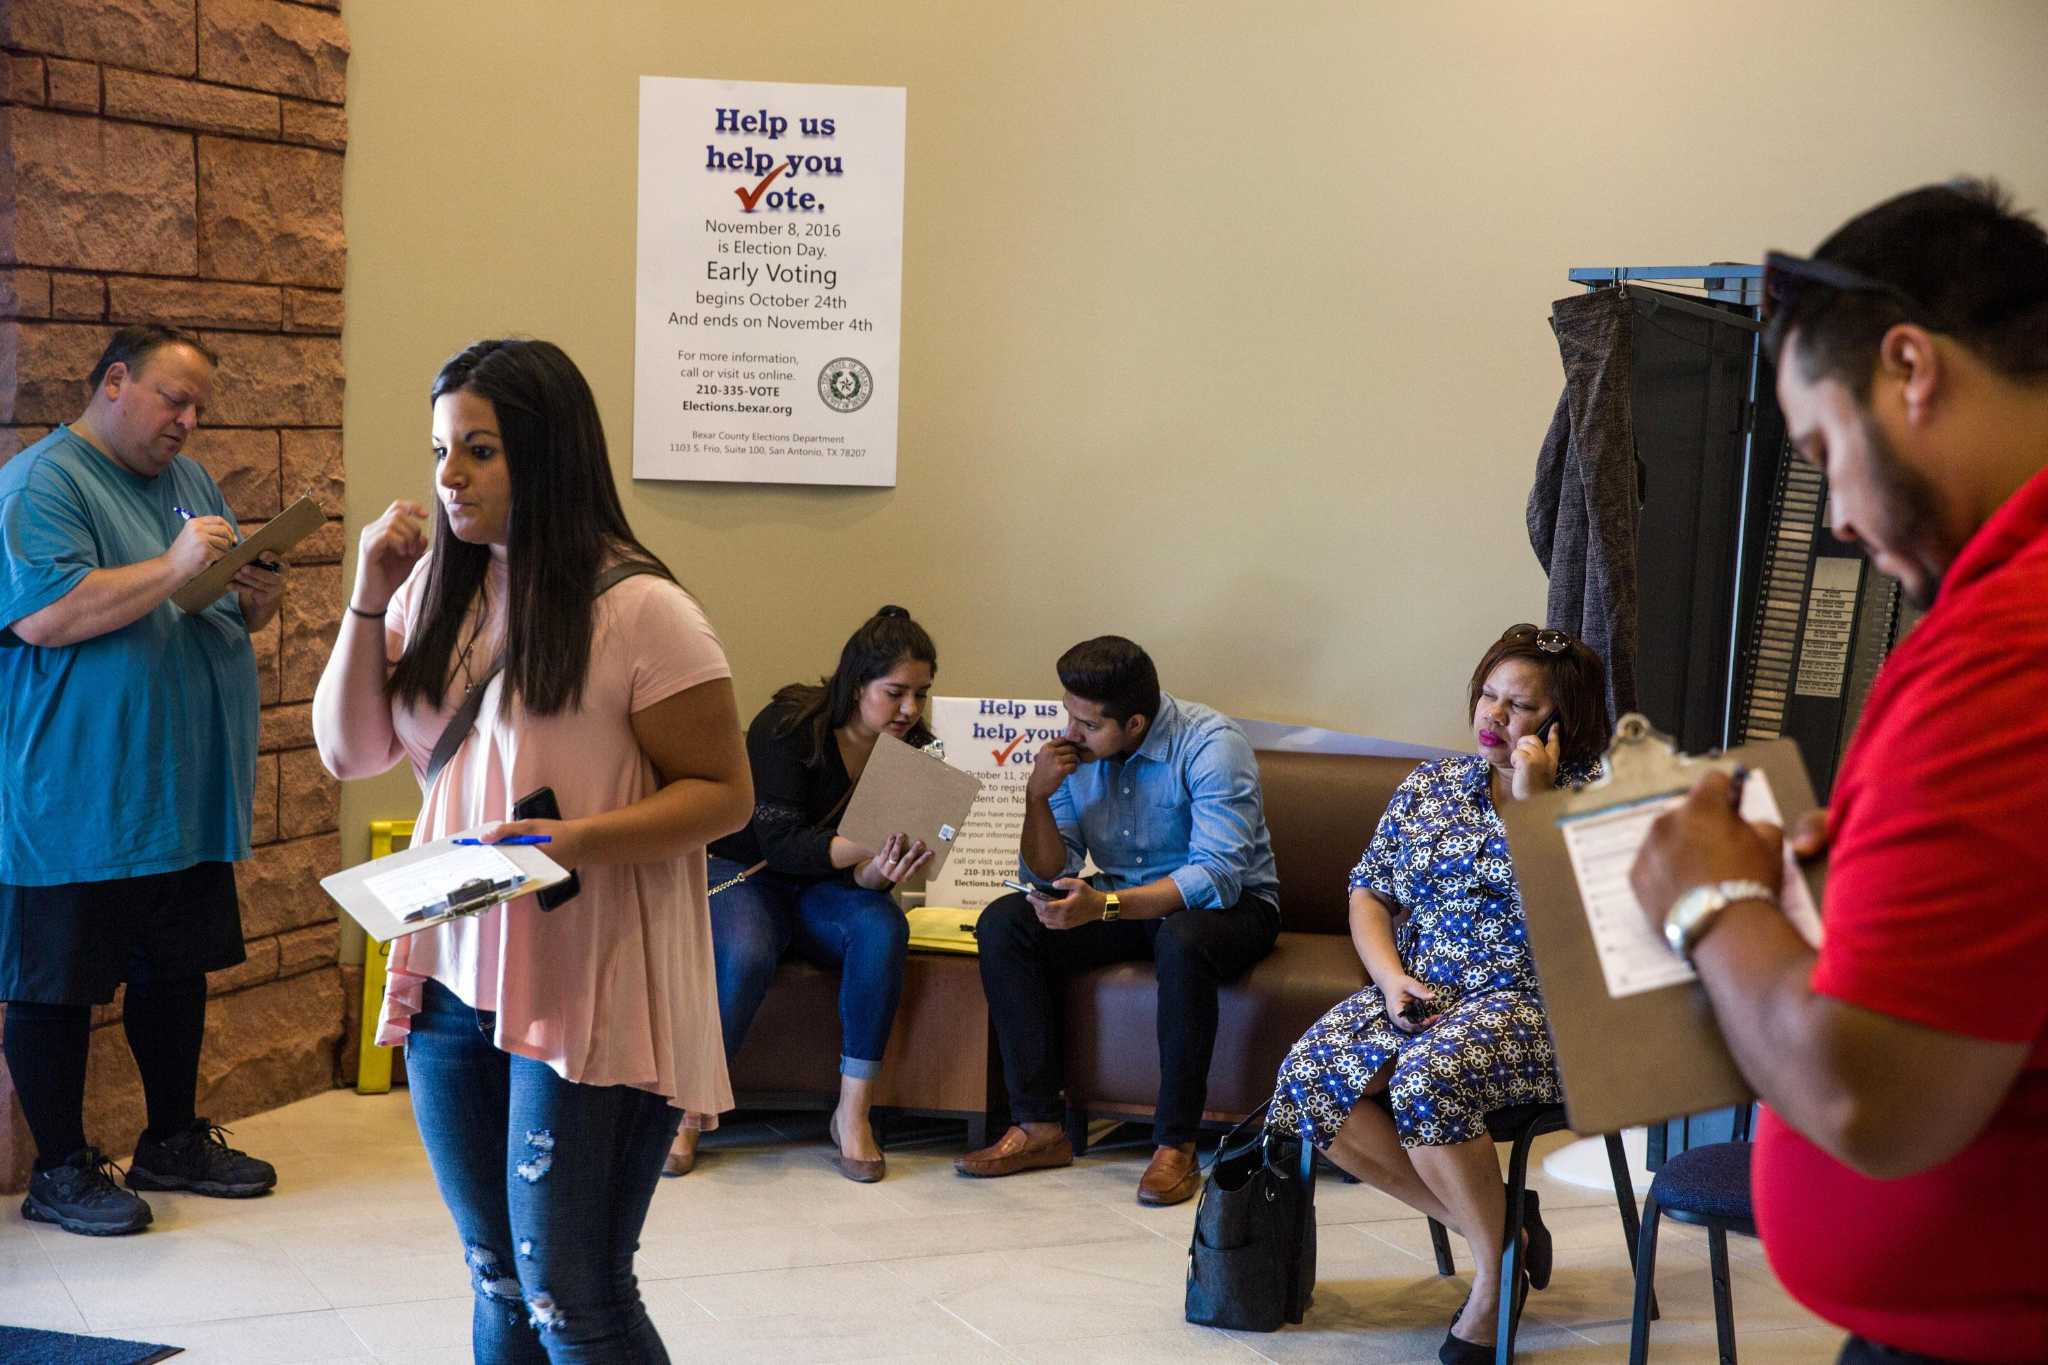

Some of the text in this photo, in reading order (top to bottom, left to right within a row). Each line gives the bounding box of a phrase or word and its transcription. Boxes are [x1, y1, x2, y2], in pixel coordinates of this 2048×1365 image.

[716, 108, 836, 139] Help us
[706, 145, 843, 178] help you
[705, 220, 841, 238] November 8, 2016
[718, 239, 828, 260] is Election Day.
[707, 260, 837, 290] Early Voting
[696, 291, 847, 310] begins October 24th
[668, 312, 873, 332] And ends on November 4th
[678, 350, 800, 366] For more information,
[680, 367, 797, 381] call or visit us online.
[696, 384, 781, 397] 210-335-VOTE
[682, 400, 793, 417] Elections.bexar.org
[692, 431, 845, 445] Bexar County Elections Department
[670, 443, 691, 452] 1103
[703, 444, 722, 455] Frio,
[724, 445, 746, 454] Suite
[749, 446, 765, 456] 100,
[768, 446, 785, 456] San
[787, 447, 824, 457] Antonio,
[826, 448, 838, 457] TX
[839, 448, 866, 458] 78207
[979, 700, 1058, 719] Help us
[972, 723, 1062, 743] help you
[1004, 771, 1017, 781] 11,
[1000, 783, 1026, 794] regist
[1011, 795, 1025, 804] No
[987, 810, 1005, 818] have
[987, 847, 1019, 855] informat
[953, 857, 966, 865] call
